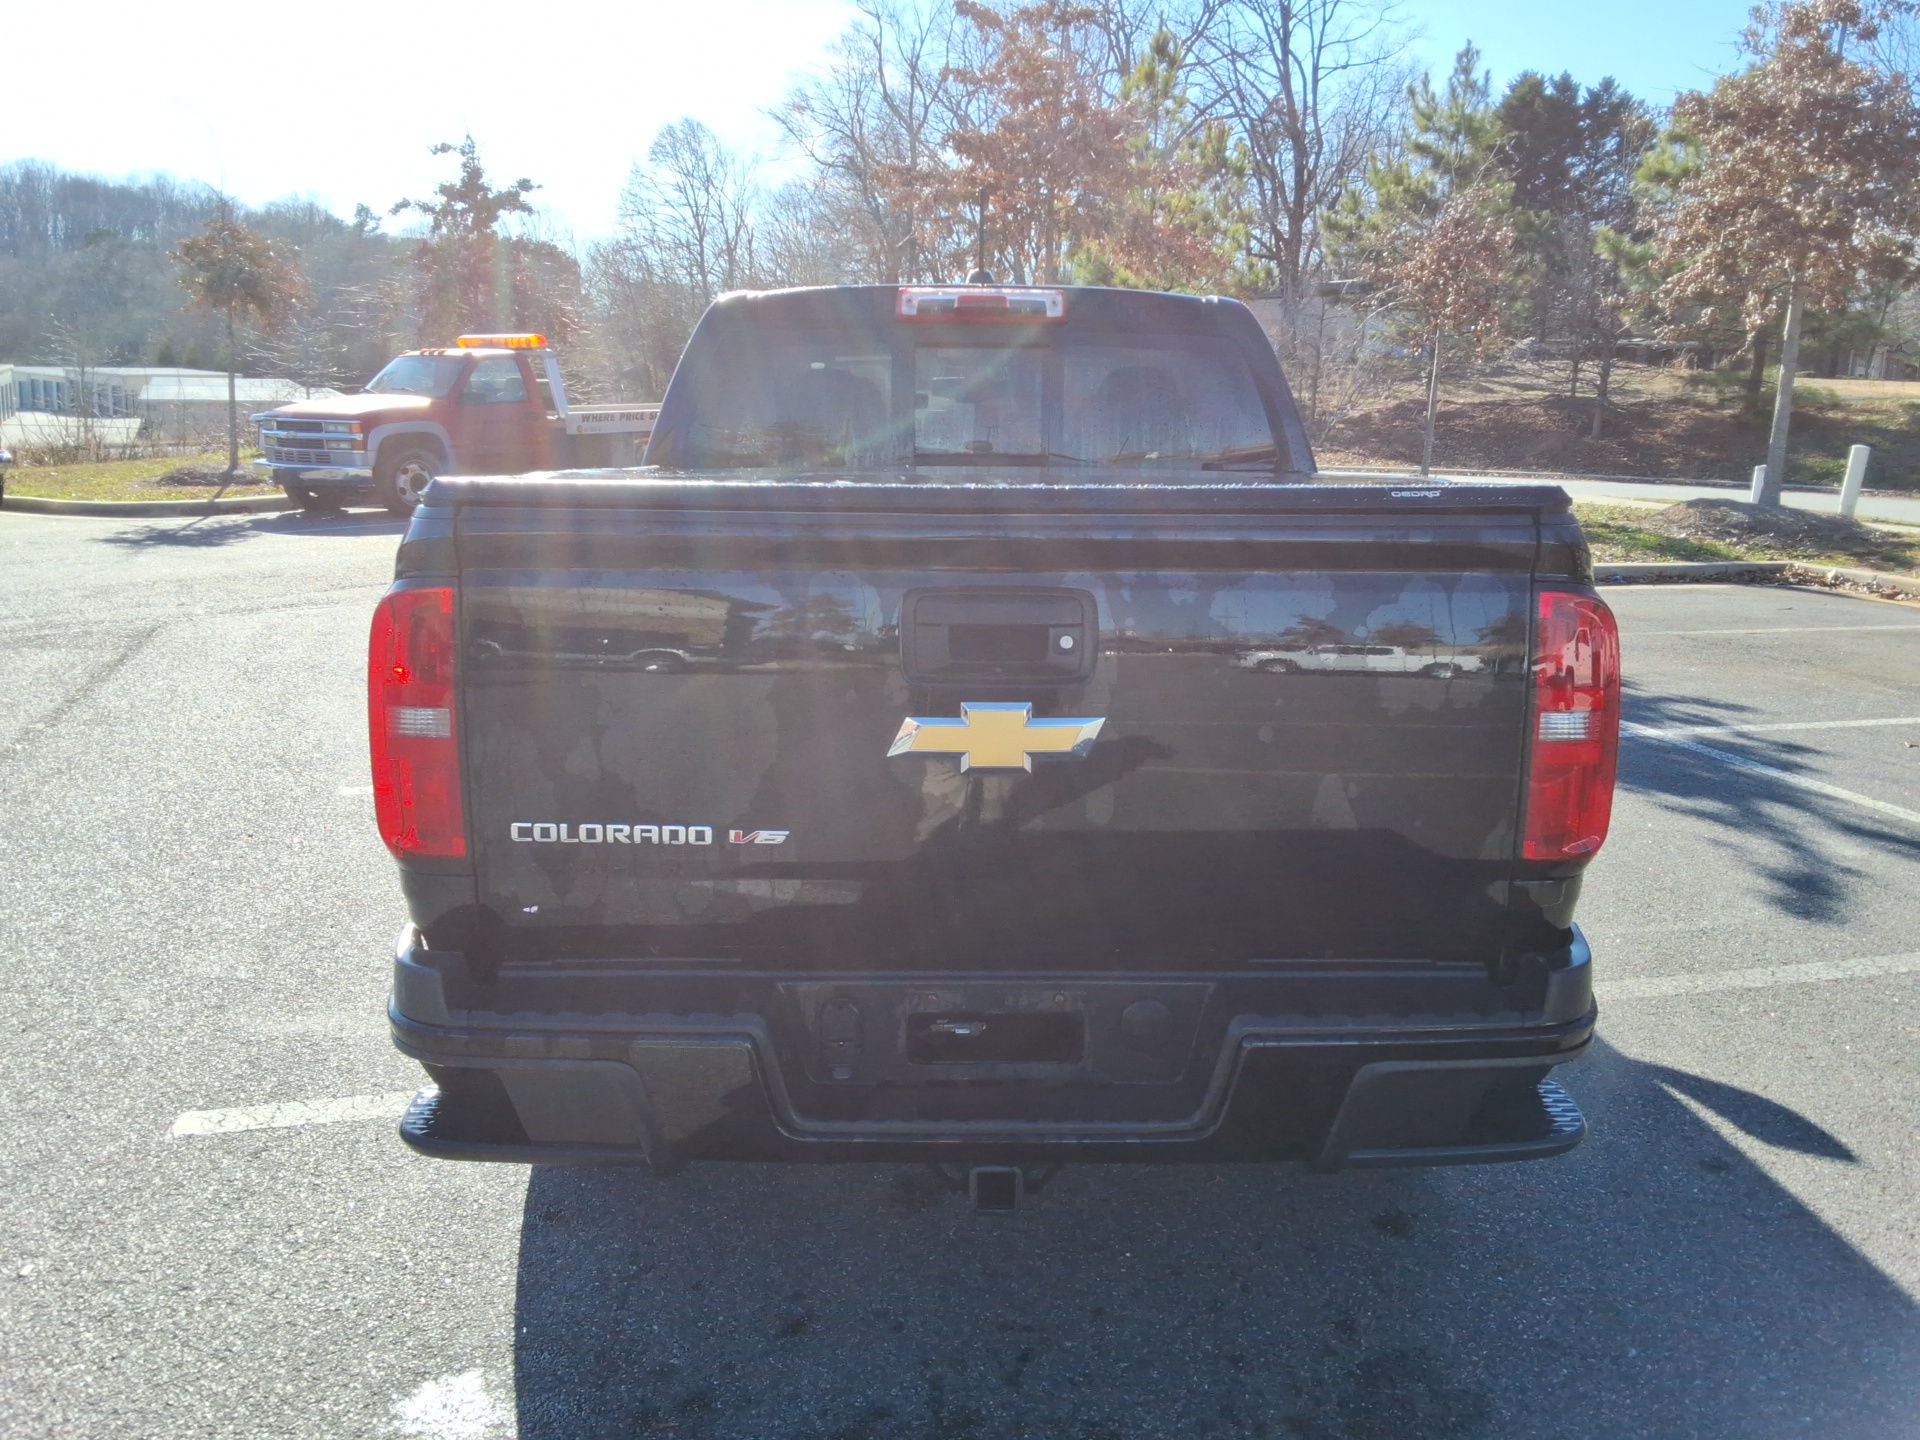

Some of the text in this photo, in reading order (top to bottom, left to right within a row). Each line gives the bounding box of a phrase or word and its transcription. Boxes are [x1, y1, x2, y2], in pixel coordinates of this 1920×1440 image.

[581, 413, 615, 423] WHERE
[619, 412, 645, 421] PRICE
[510, 822, 790, 845] COLORADO V6
